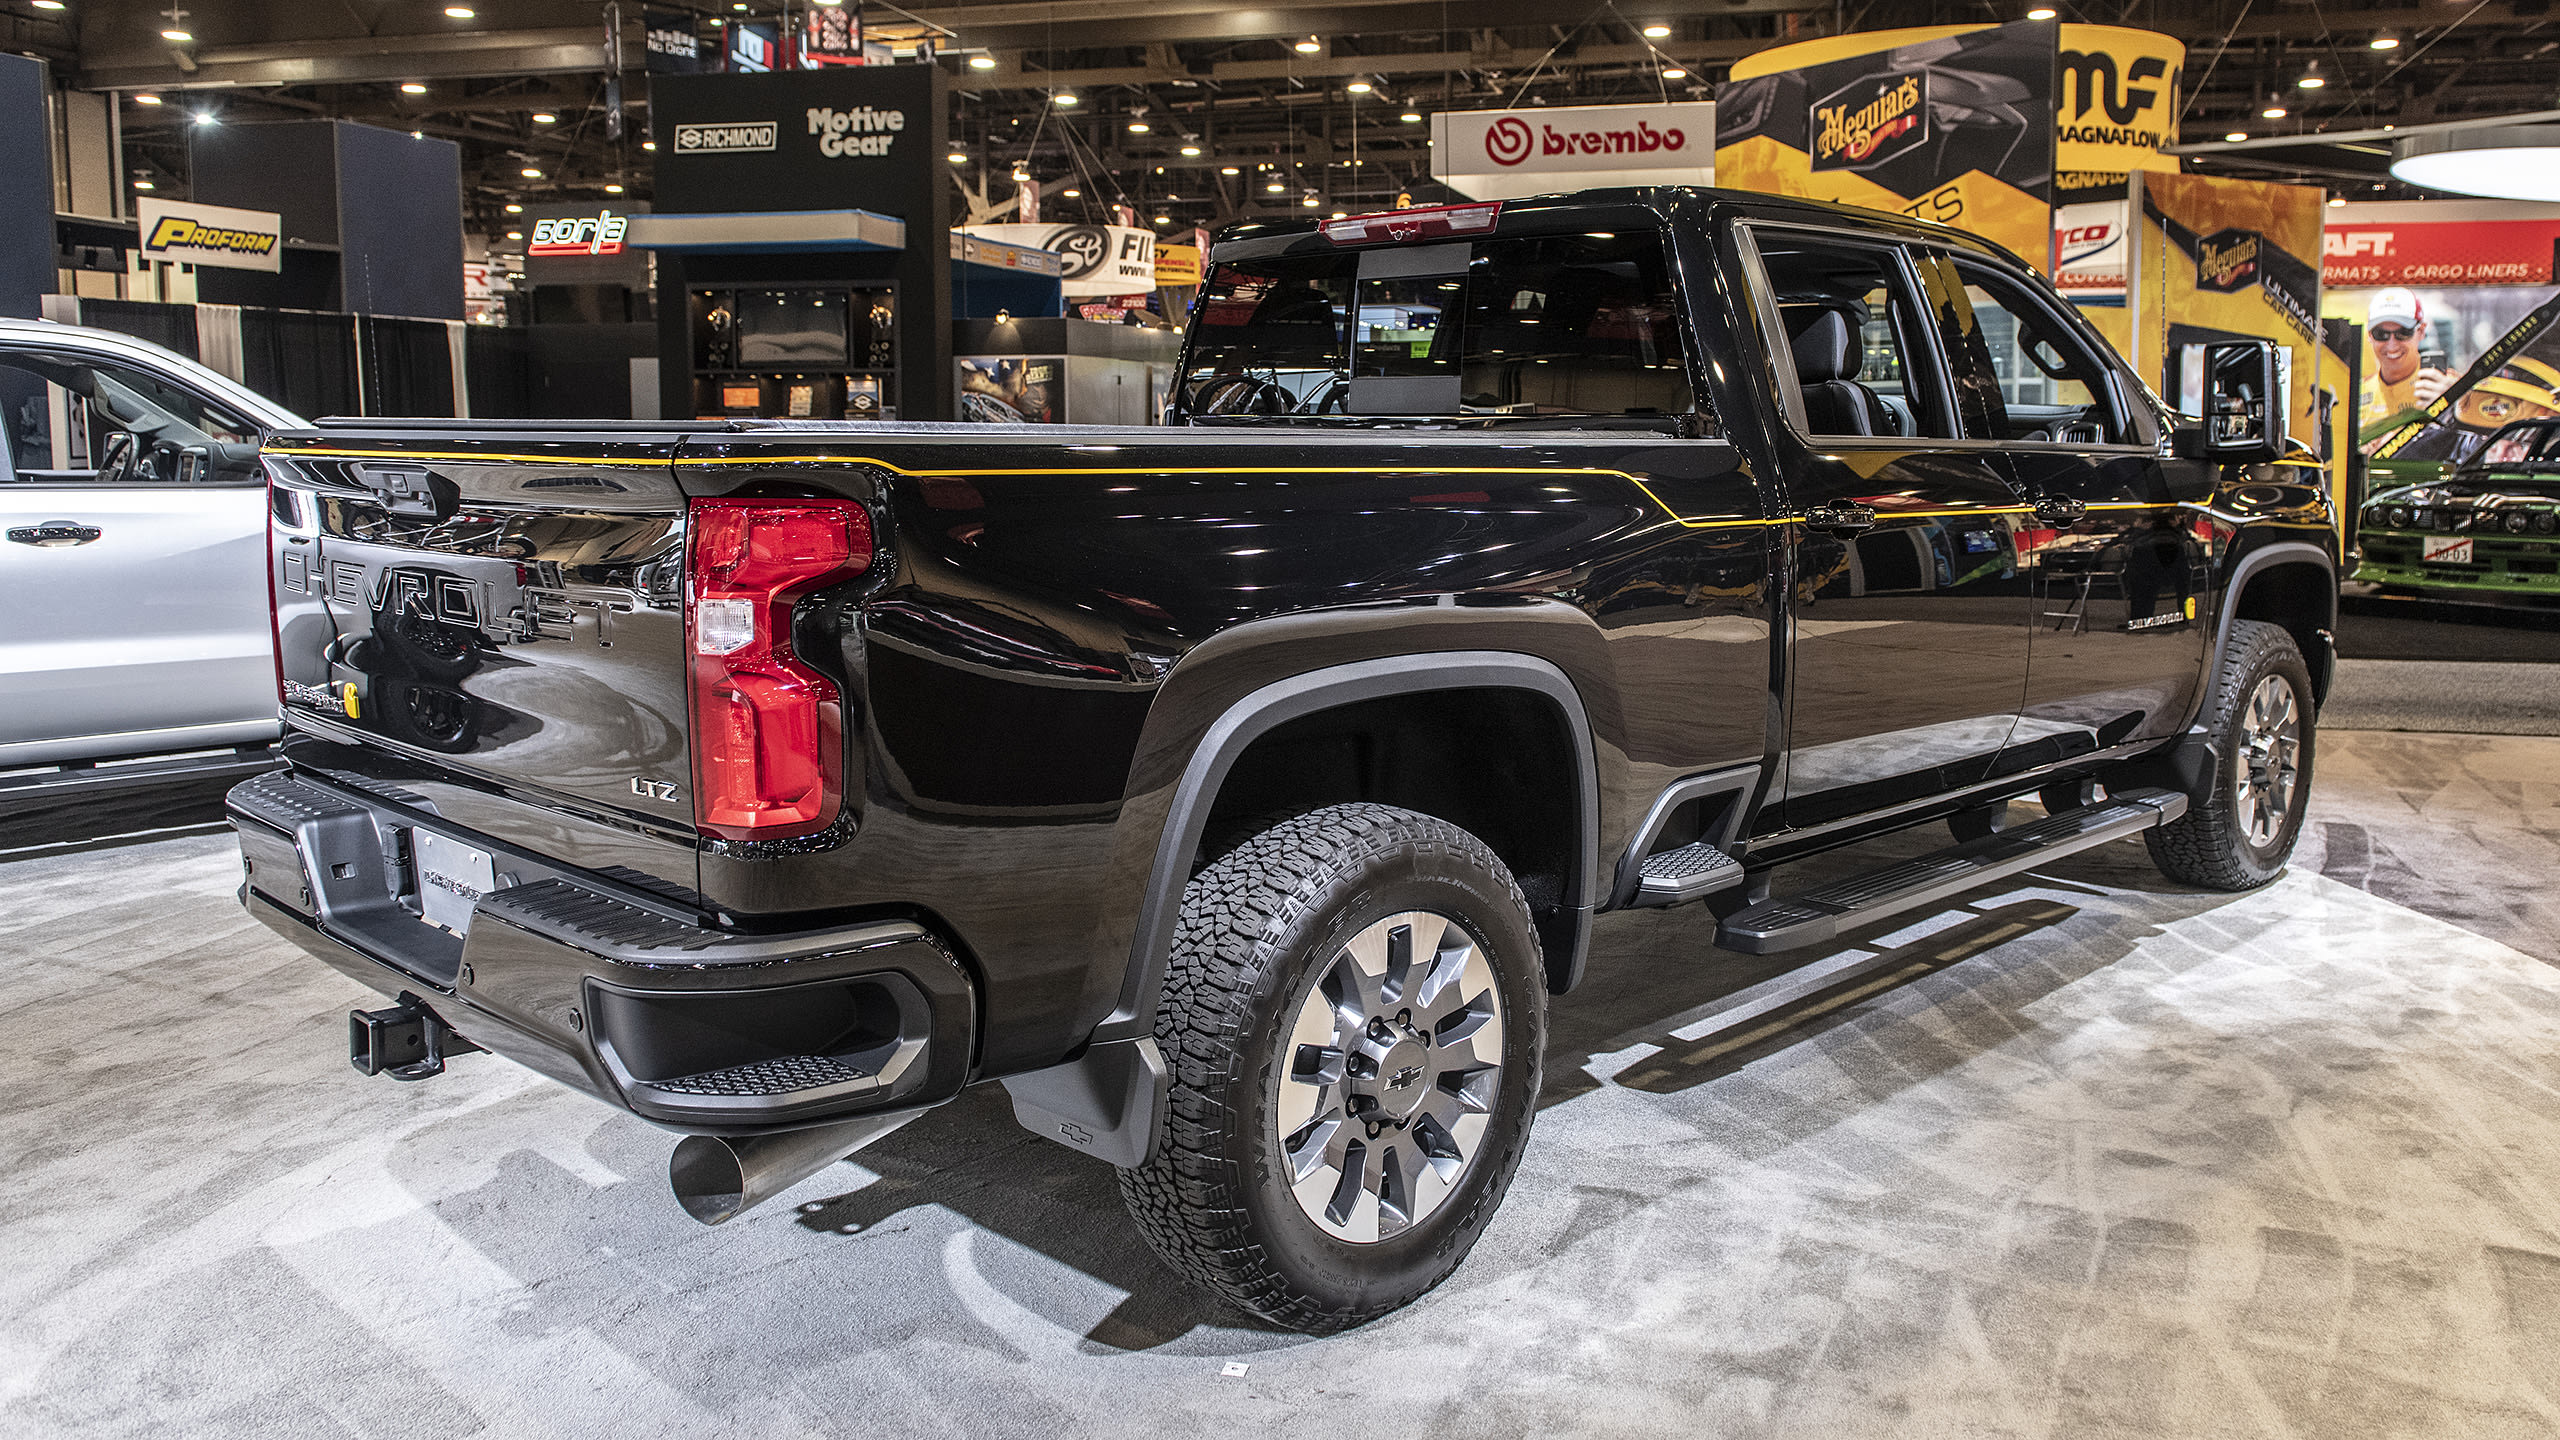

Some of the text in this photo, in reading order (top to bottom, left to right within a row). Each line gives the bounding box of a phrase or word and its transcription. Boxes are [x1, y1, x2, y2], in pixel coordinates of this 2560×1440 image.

[806, 106, 905, 135] Motive
[702, 127, 773, 149] RICHMOND
[820, 132, 894, 159] Gear
[1543, 121, 1685, 156] brembo
[2403, 264, 2463, 279] CARGO
[2467, 263, 2528, 278] LINERS
[2263, 291, 2315, 346] CAR CARE
[283, 550, 636, 650] CHEVROLET
[631, 775, 680, 803] LTZ
